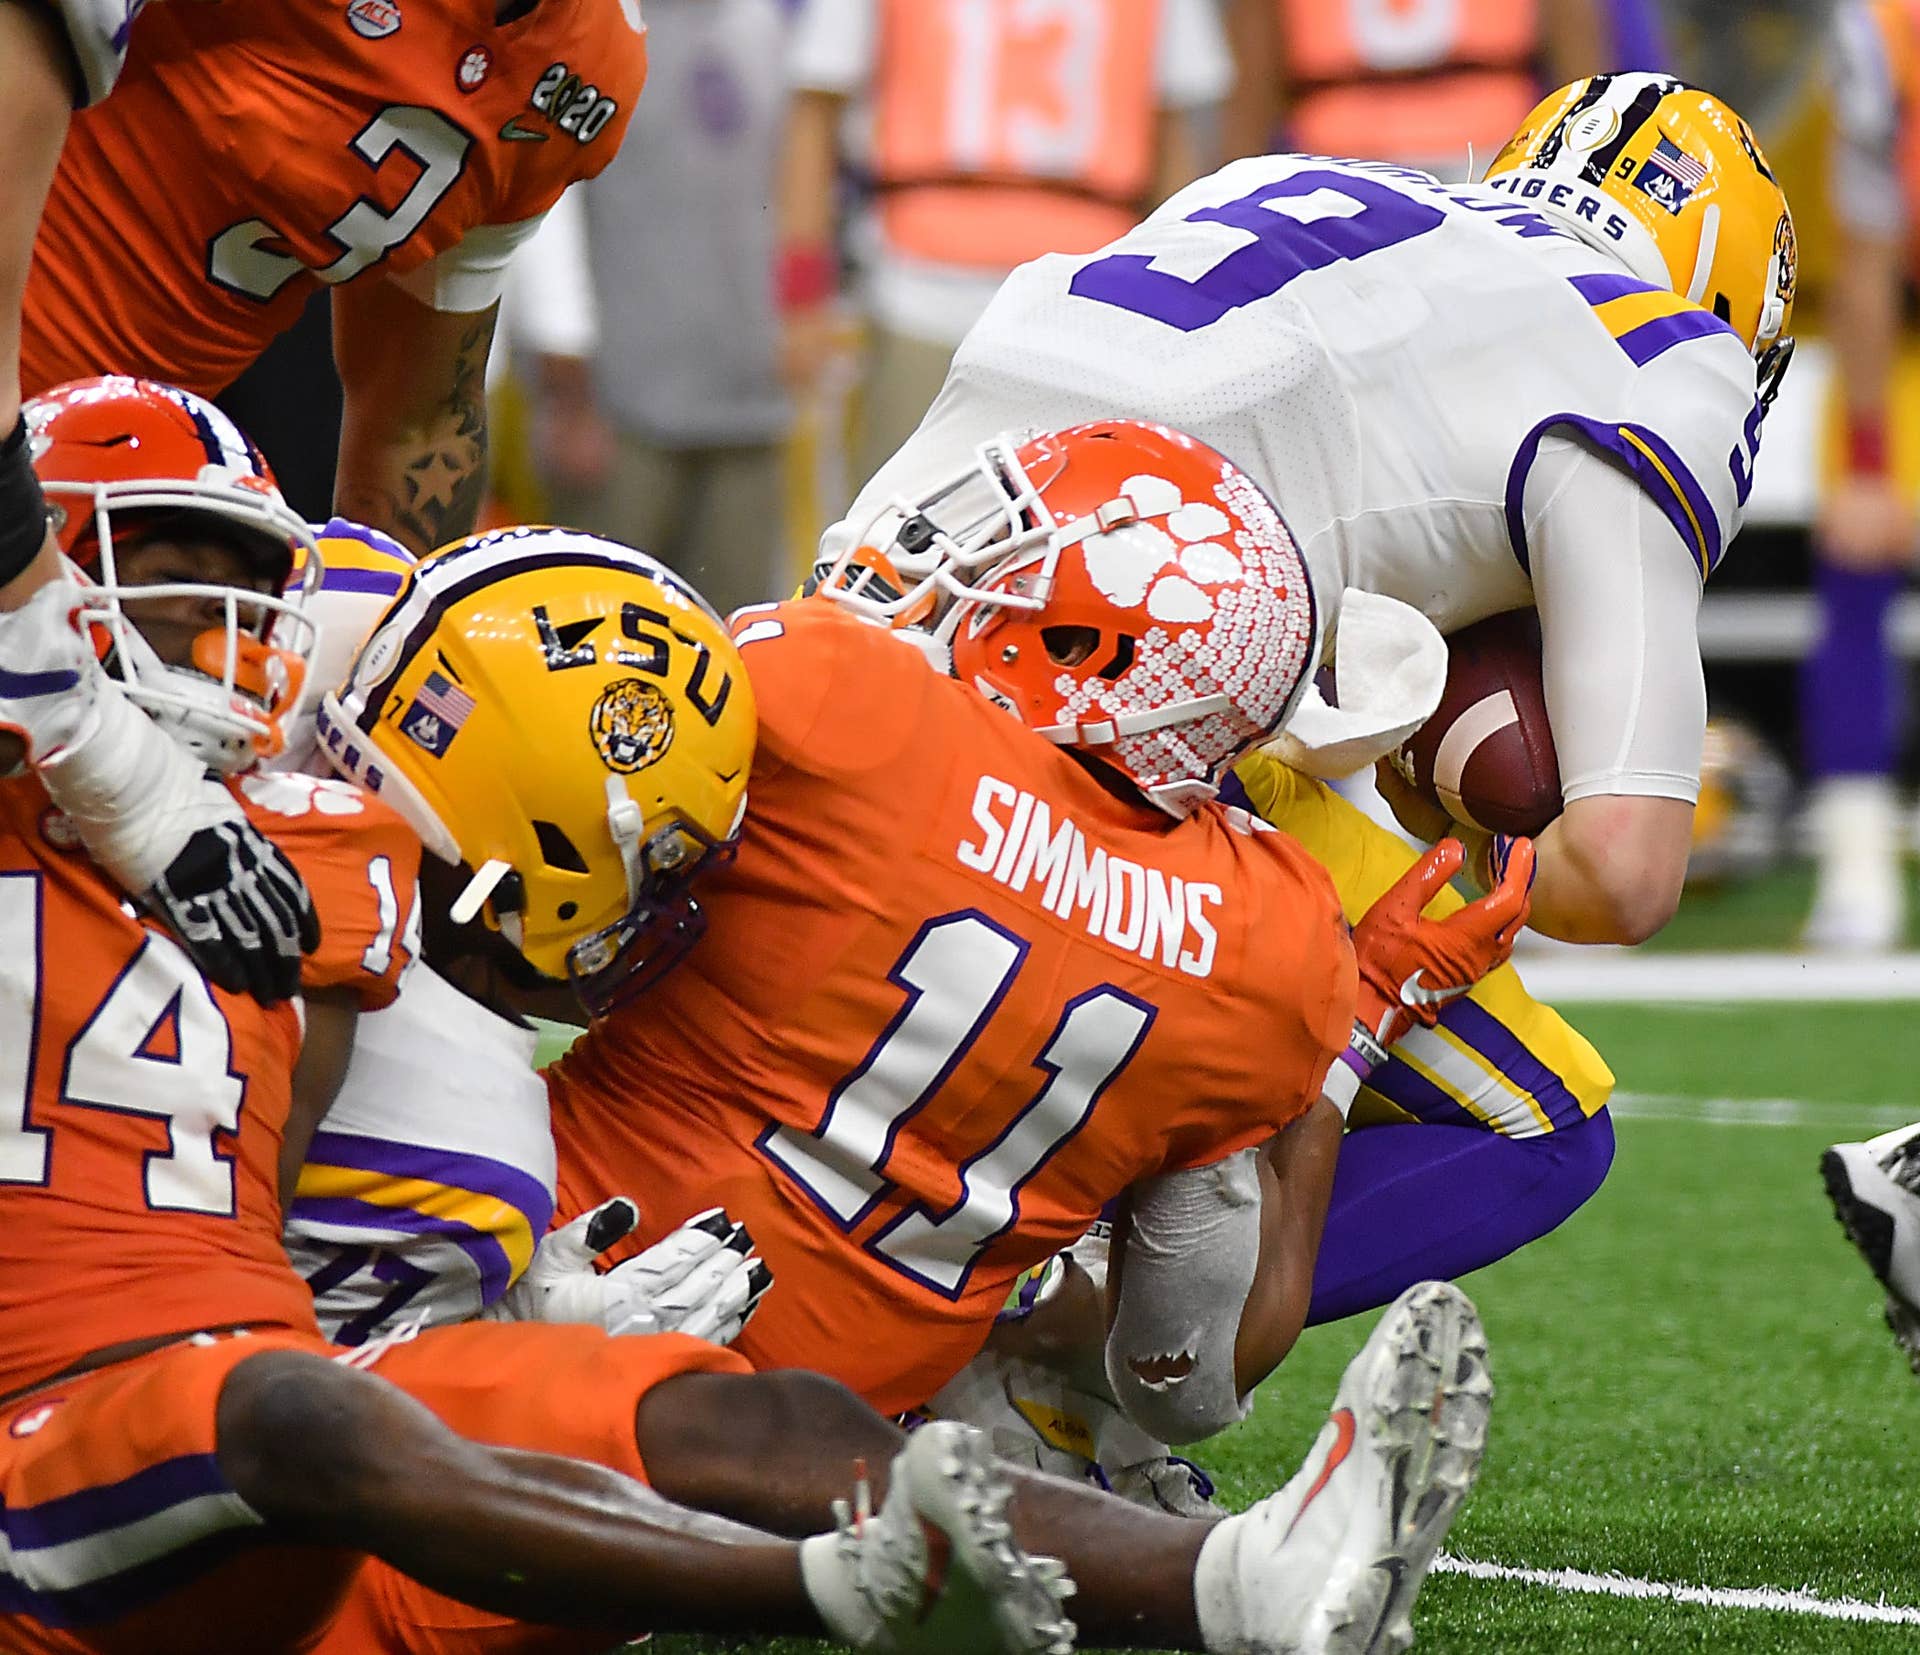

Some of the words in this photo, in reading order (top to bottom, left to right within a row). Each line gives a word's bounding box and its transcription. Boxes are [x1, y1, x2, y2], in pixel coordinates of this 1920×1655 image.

[352, 1, 397, 26] ACC
[531, 62, 617, 144] 2020
[1614, 156, 1637, 180] 9
[206, 104, 472, 299] 3
[1069, 168, 1449, 333] 9
[386, 695, 404, 720] 7
[532, 602, 733, 727] LSU
[957, 775, 1223, 978] SIMMONS
[0, 868, 246, 1219] 14
[754, 907, 1159, 1301] 11
